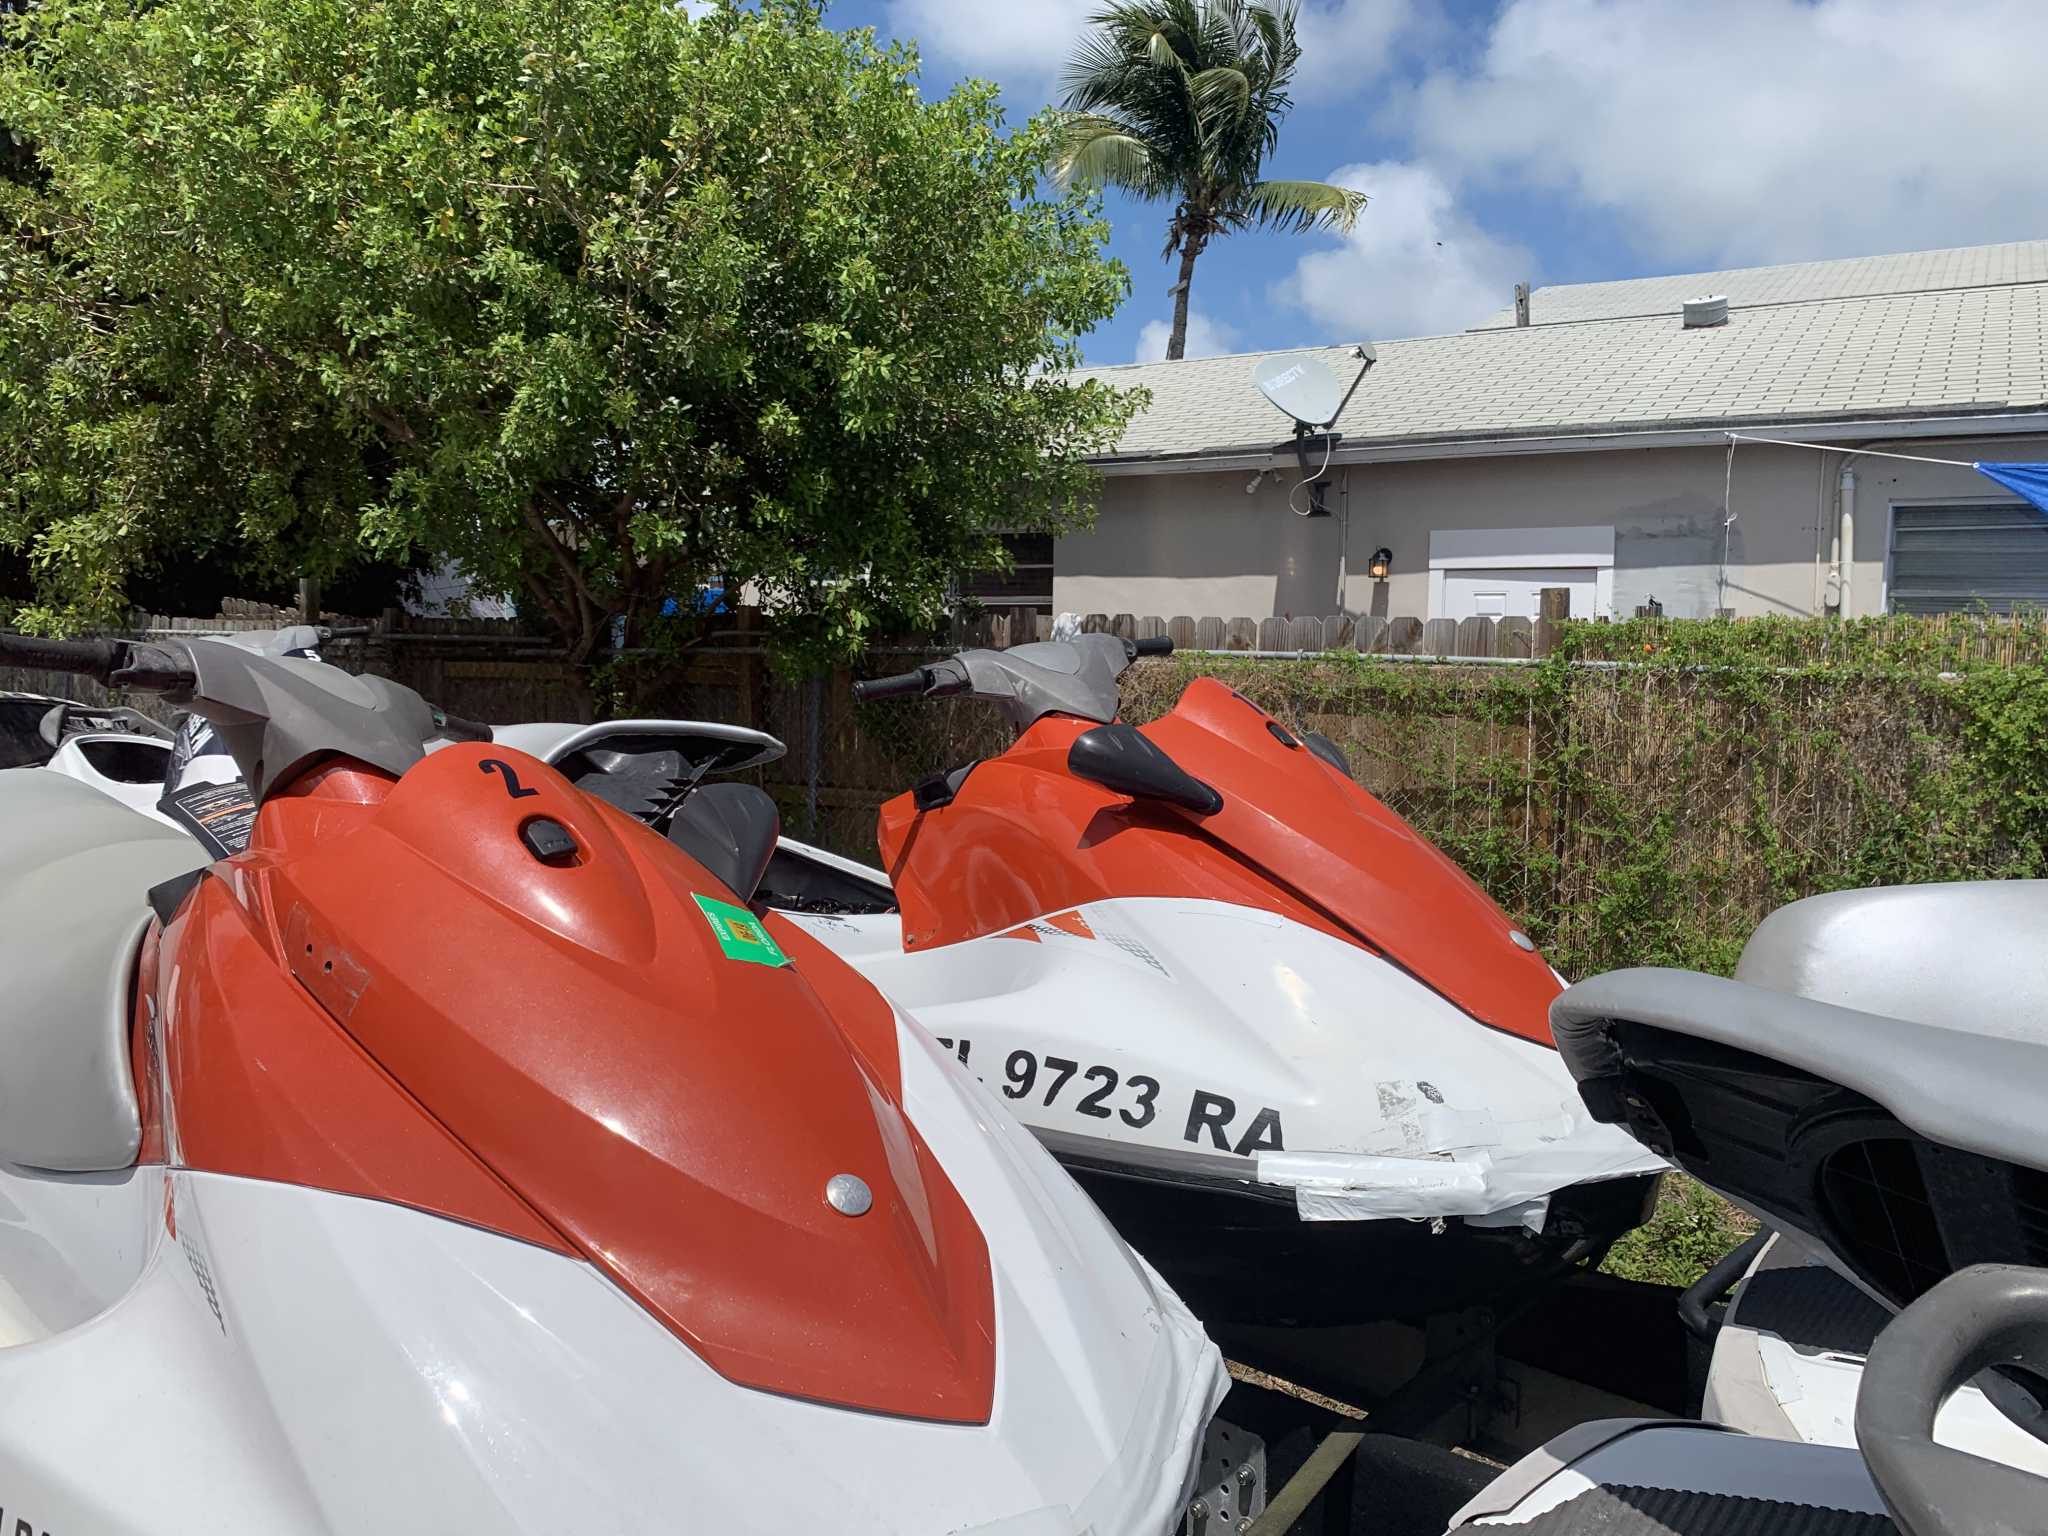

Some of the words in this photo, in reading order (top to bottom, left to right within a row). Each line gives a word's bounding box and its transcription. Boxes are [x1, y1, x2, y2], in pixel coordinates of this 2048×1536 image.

[303, 649, 322, 662] 5
[478, 759, 540, 798] 2
[1002, 1049, 1161, 1129] 9723
[1183, 1089, 1285, 1157] RA
